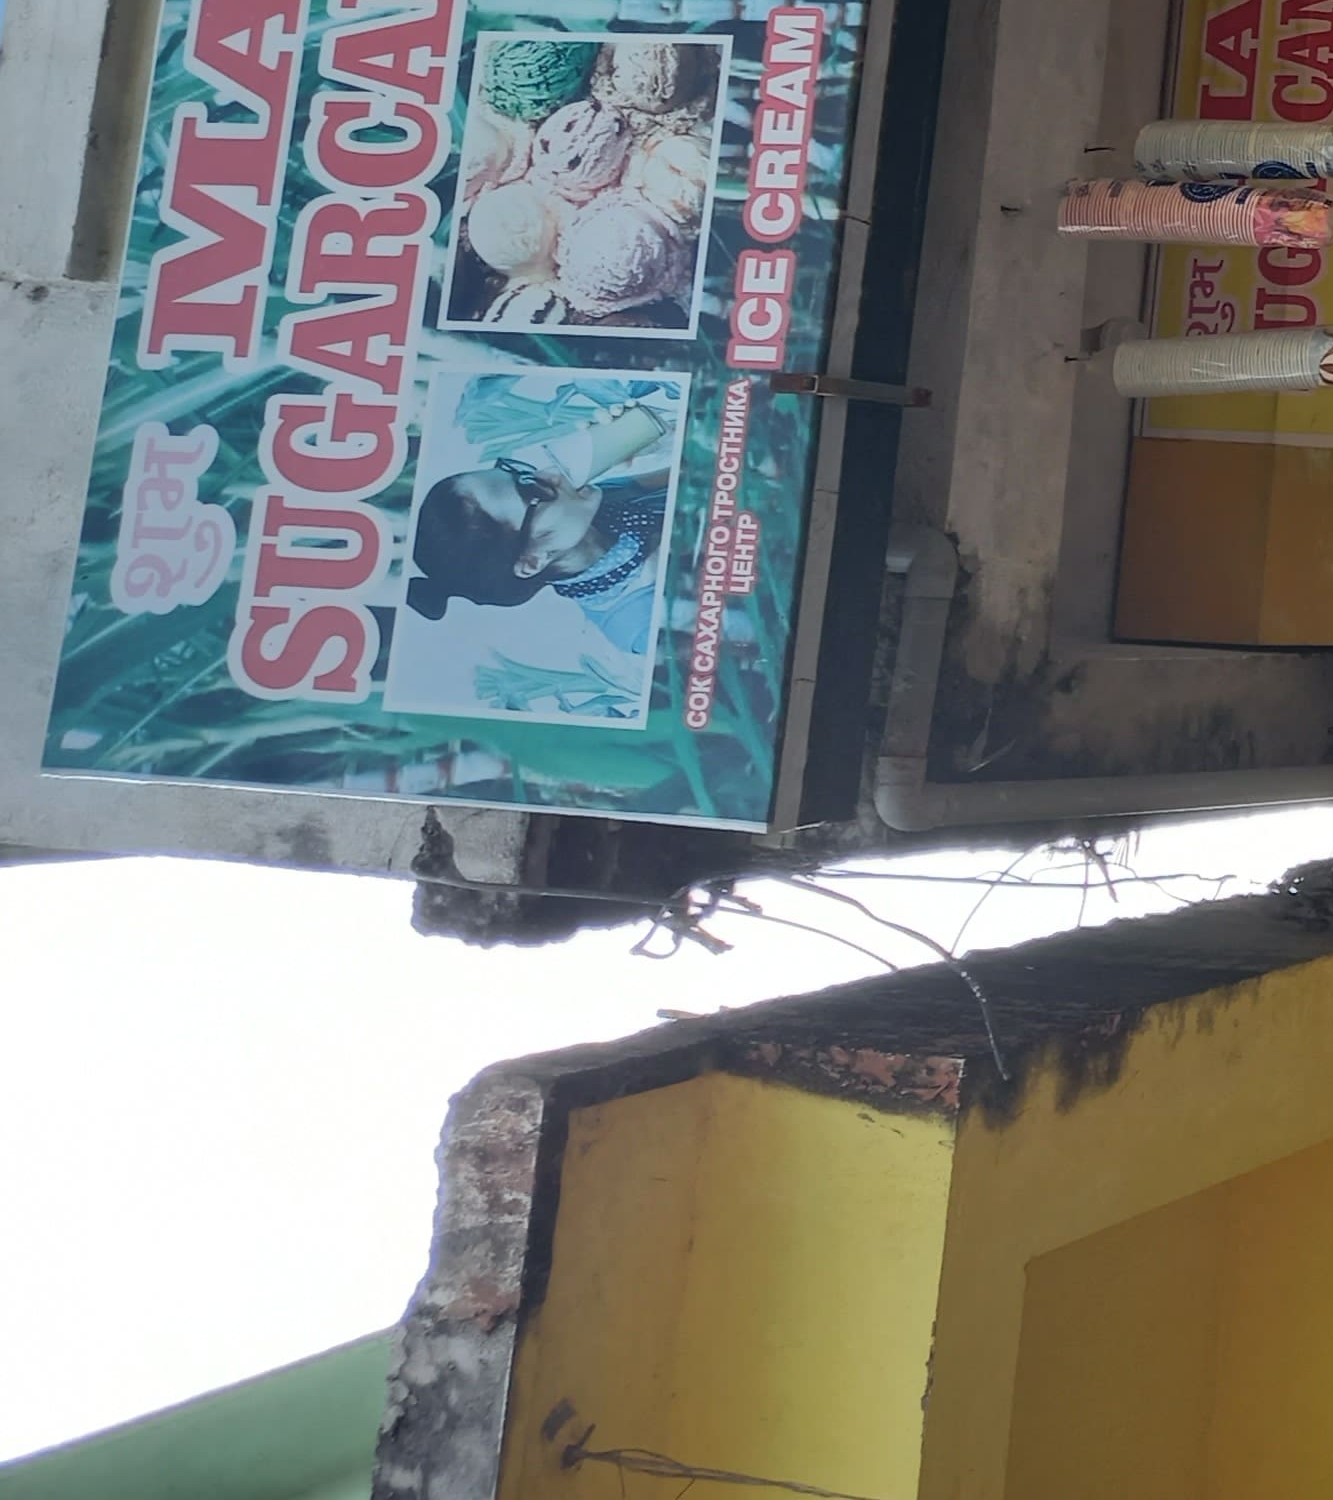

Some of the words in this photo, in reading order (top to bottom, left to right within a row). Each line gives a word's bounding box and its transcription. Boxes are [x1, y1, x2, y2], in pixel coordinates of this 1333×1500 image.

[750, 13, 818, 236] CREAM
[734, 252, 790, 363] ICE
[711, 379, 750, 520] ТРОСТНИКА
[694, 525, 731, 672] САХАРНОГО
[730, 513, 758, 593] ЦЕНТР
[685, 677, 712, 728] СОК
